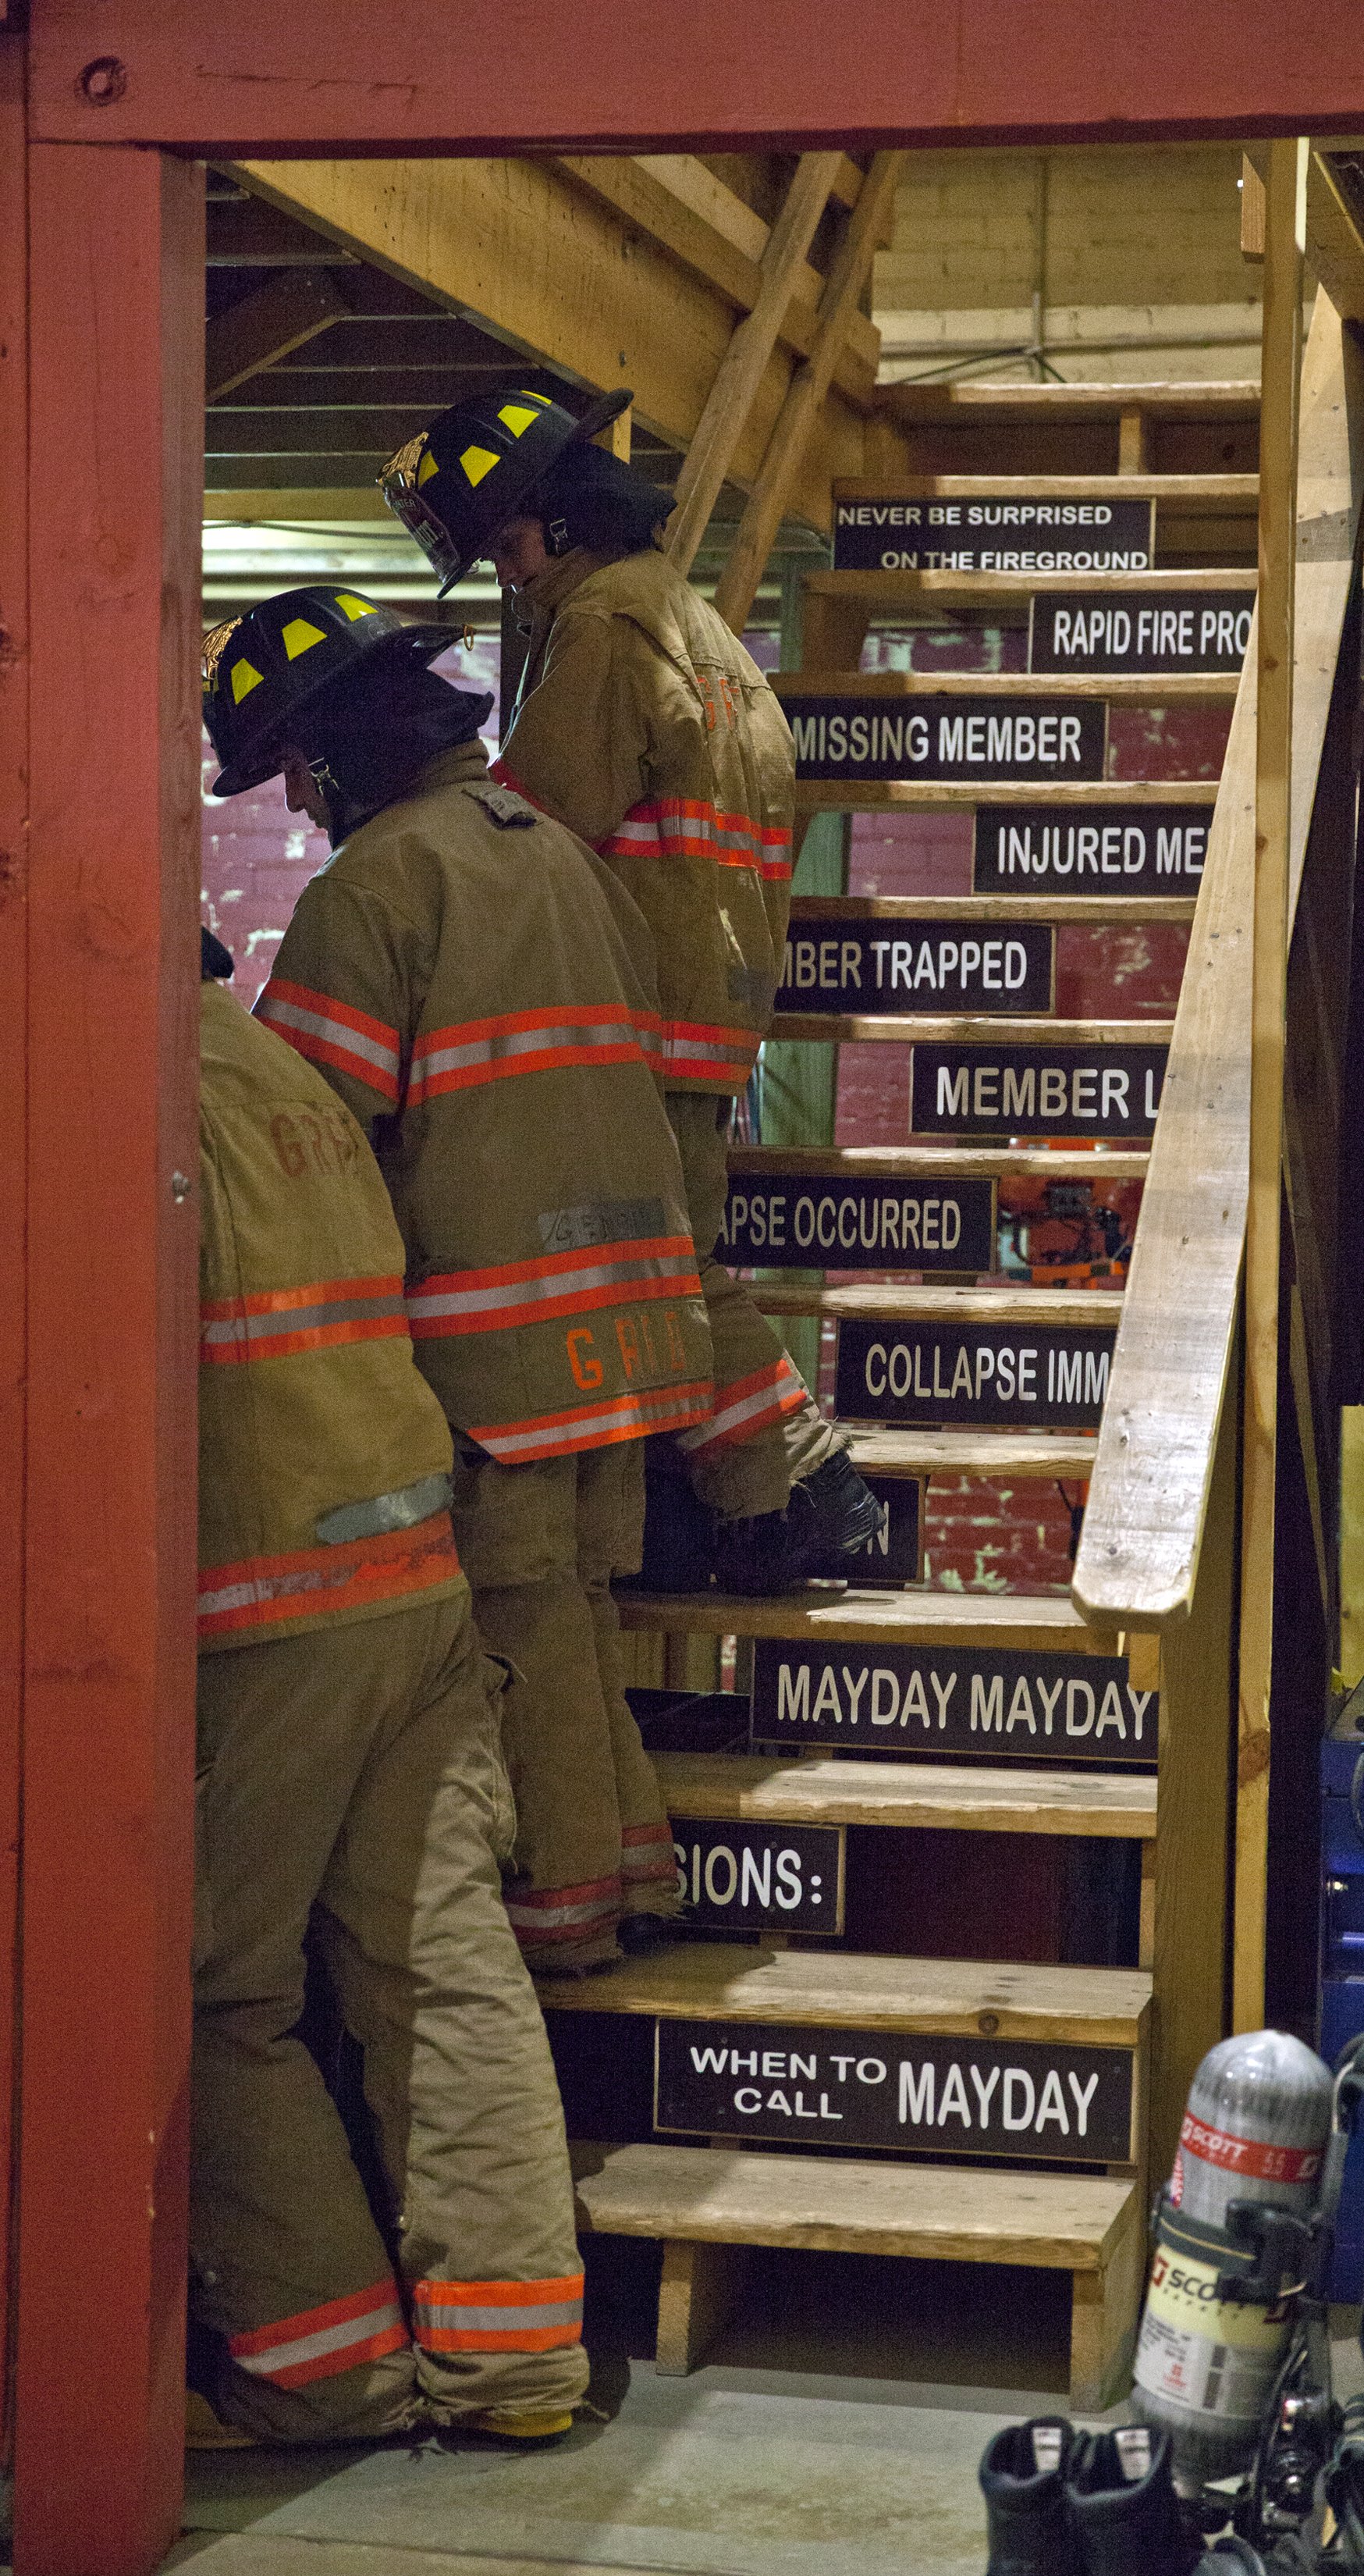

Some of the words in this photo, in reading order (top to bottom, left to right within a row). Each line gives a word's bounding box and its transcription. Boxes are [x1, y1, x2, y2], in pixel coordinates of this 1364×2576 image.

[837, 507, 922, 526] NEVER
[929, 507, 962, 525] BE
[967, 505, 1113, 526] SURPRISED
[880, 551, 918, 570] ON
[925, 551, 974, 570] THE
[981, 551, 1149, 570] FIREGROUND
[1053, 610, 1131, 655] RAPID
[1137, 610, 1195, 655] FIRE
[1201, 610, 1252, 655] PRO
[792, 716, 929, 762] MISSING
[938, 717, 1082, 763] MEMBER
[998, 827, 1146, 874] INJURED
[1156, 827, 1211, 873] ME
[870, 941, 1028, 990] TRAPPED
[936, 1066, 1131, 1119] MEMBER
[1145, 1069, 1159, 1118] L
[794, 1196, 961, 1251] OCCURRED
[865, 1343, 1038, 1402] COLLAPSE
[1048, 1349, 1109, 1404] IMM
[778, 1664, 957, 1730] MAYDAY
[970, 1674, 1153, 1741] MAYDAY
[691, 2047, 817, 2080] WHEN
[829, 2056, 887, 2084] TO
[734, 2087, 844, 2119] CALL
[899, 2061, 1099, 2137] MAYDAY
[1168, 2269, 1229, 2305] SCO
